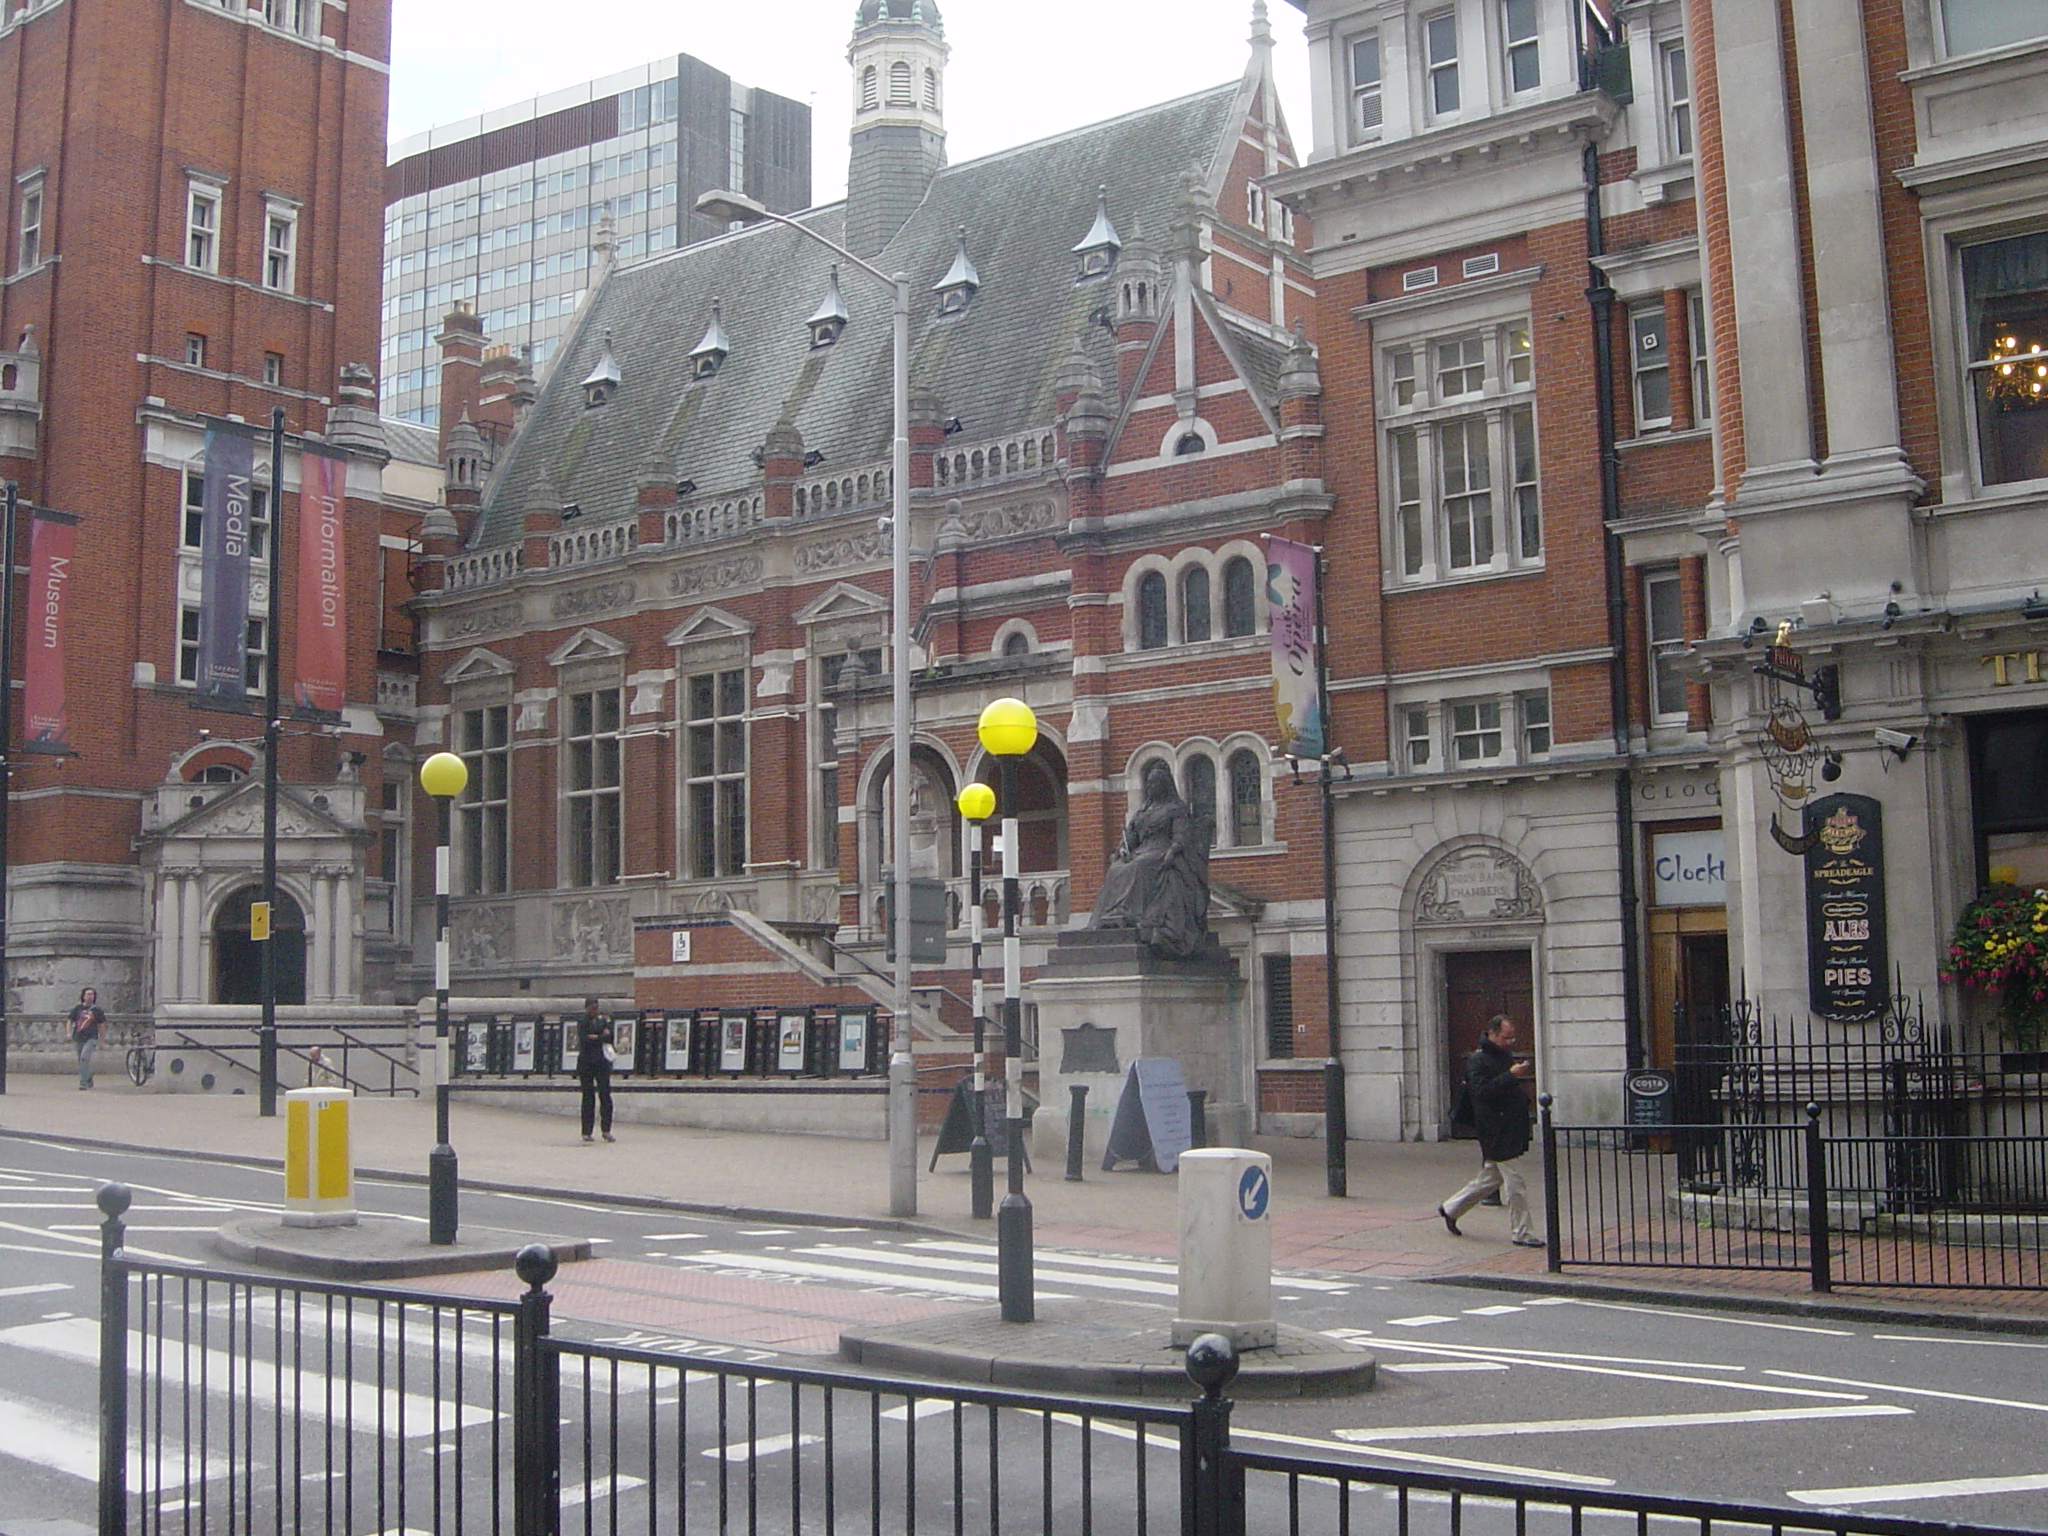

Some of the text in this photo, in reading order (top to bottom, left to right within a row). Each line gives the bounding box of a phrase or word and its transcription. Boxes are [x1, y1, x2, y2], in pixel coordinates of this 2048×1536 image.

[226, 474, 249, 556] Media
[321, 494, 341, 627] Information
[44, 556, 69, 648] Museum
[1288, 575, 1308, 676] Opera
[1813, 867, 1874, 878] SPREADEAGLE
[1451, 886, 1506, 898] CHAMBERS
[1823, 919, 1870, 941] ALES
[1824, 968, 1872, 986] PIES
[1635, 1080, 1663, 1089] COSTA
